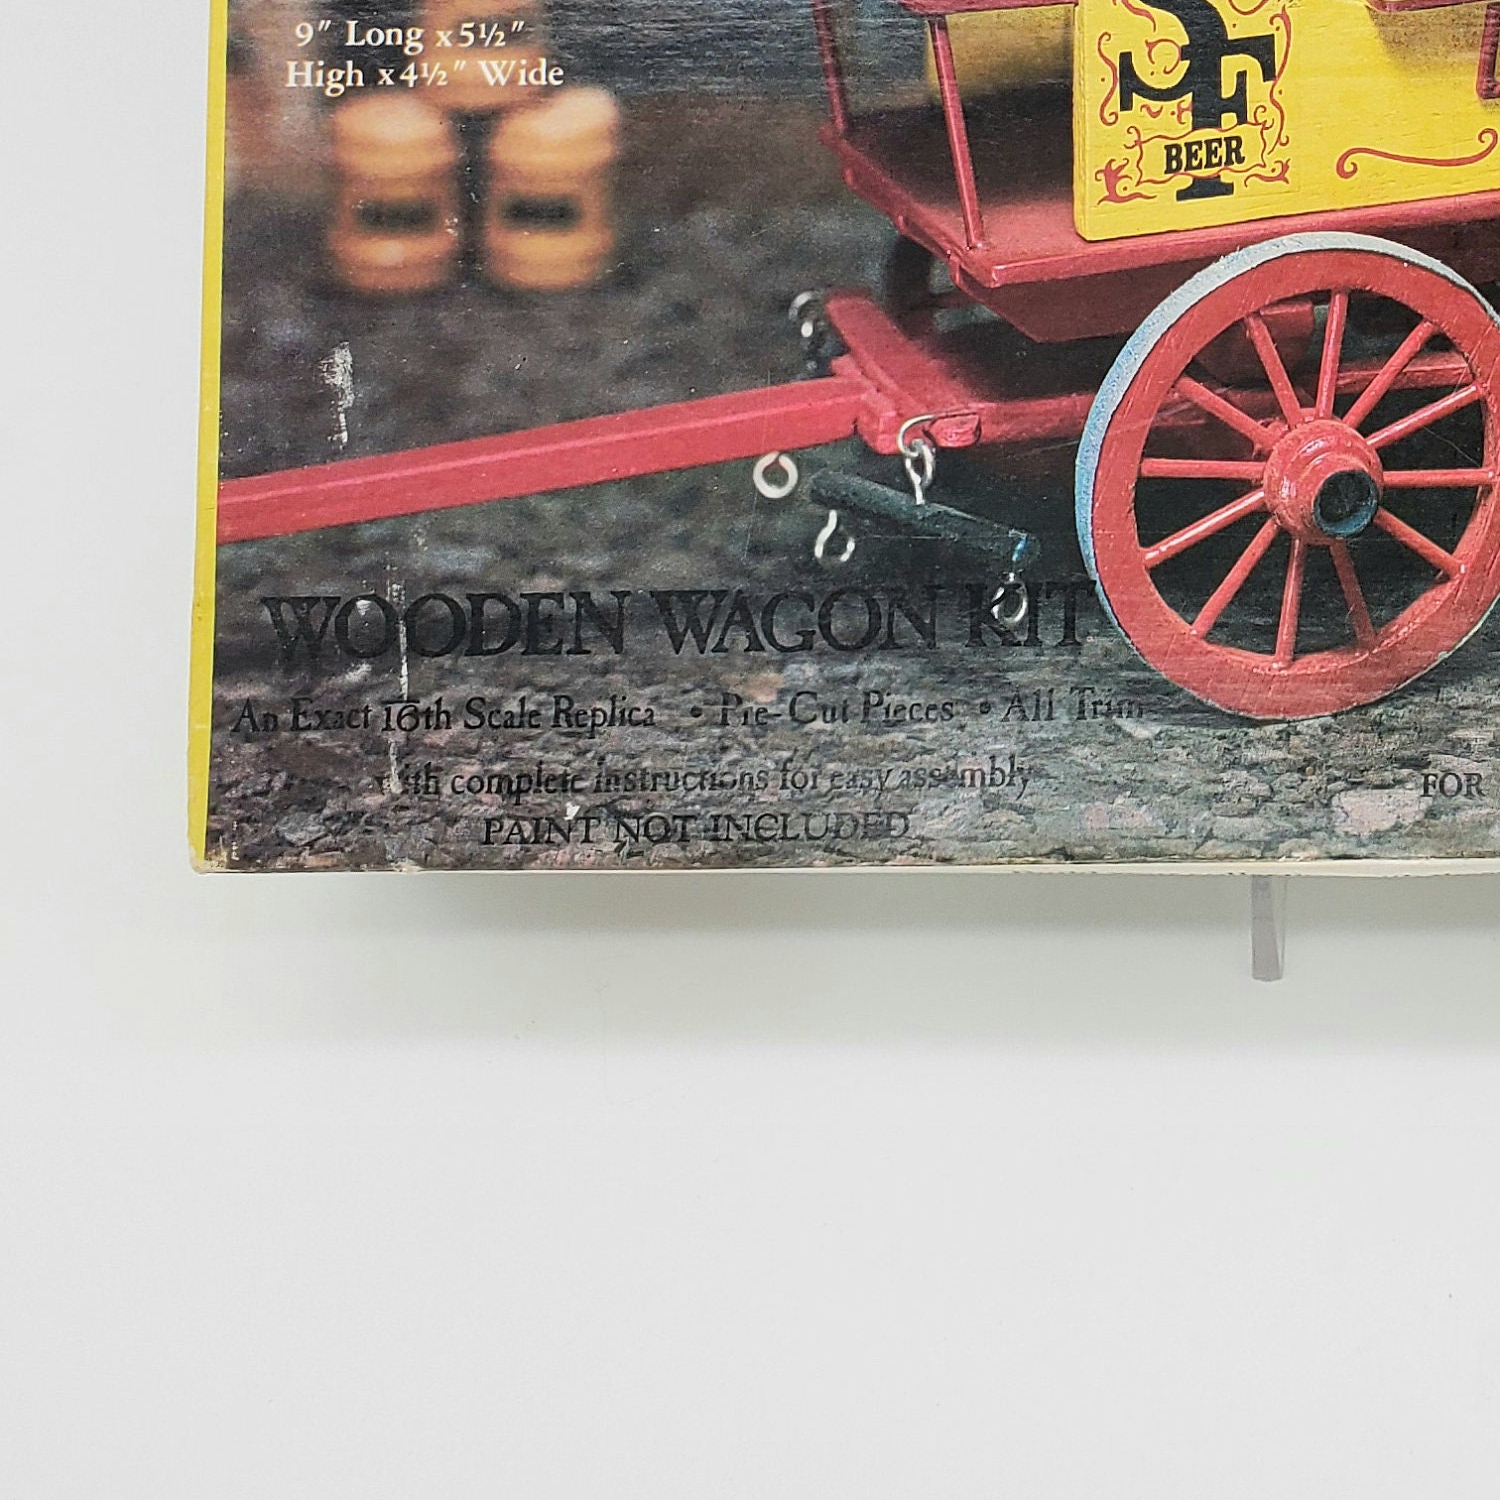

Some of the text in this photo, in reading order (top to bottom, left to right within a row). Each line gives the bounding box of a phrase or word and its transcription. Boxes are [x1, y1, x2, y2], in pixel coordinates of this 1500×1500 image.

[344, 20, 425, 55] Long
[285, 59, 365, 97] High
[478, 58, 565, 87] Wide
[1163, 135, 1246, 175] BEER
[262, 579, 1097, 657] WOODEN WAGON KIT
[231, 698, 279, 733] An
[290, 698, 373, 732] Exact
[381, 695, 452, 733] 16th
[463, 693, 542, 730] Scale
[551, 693, 656, 740] Replica
[860, 688, 954, 723] Pieces
[1000, 686, 1055, 722] All
[1070, 684, 1146, 721] Trim
[450, 760, 584, 805] complete
[594, 757, 769, 797] instructions
[779, 747, 821, 791] for
[831, 764, 896, 800] easy
[901, 754, 1033, 800] assembly
[1420, 772, 1485, 798] FOR
[482, 811, 910, 846] PAINT NOT INCLUDED
